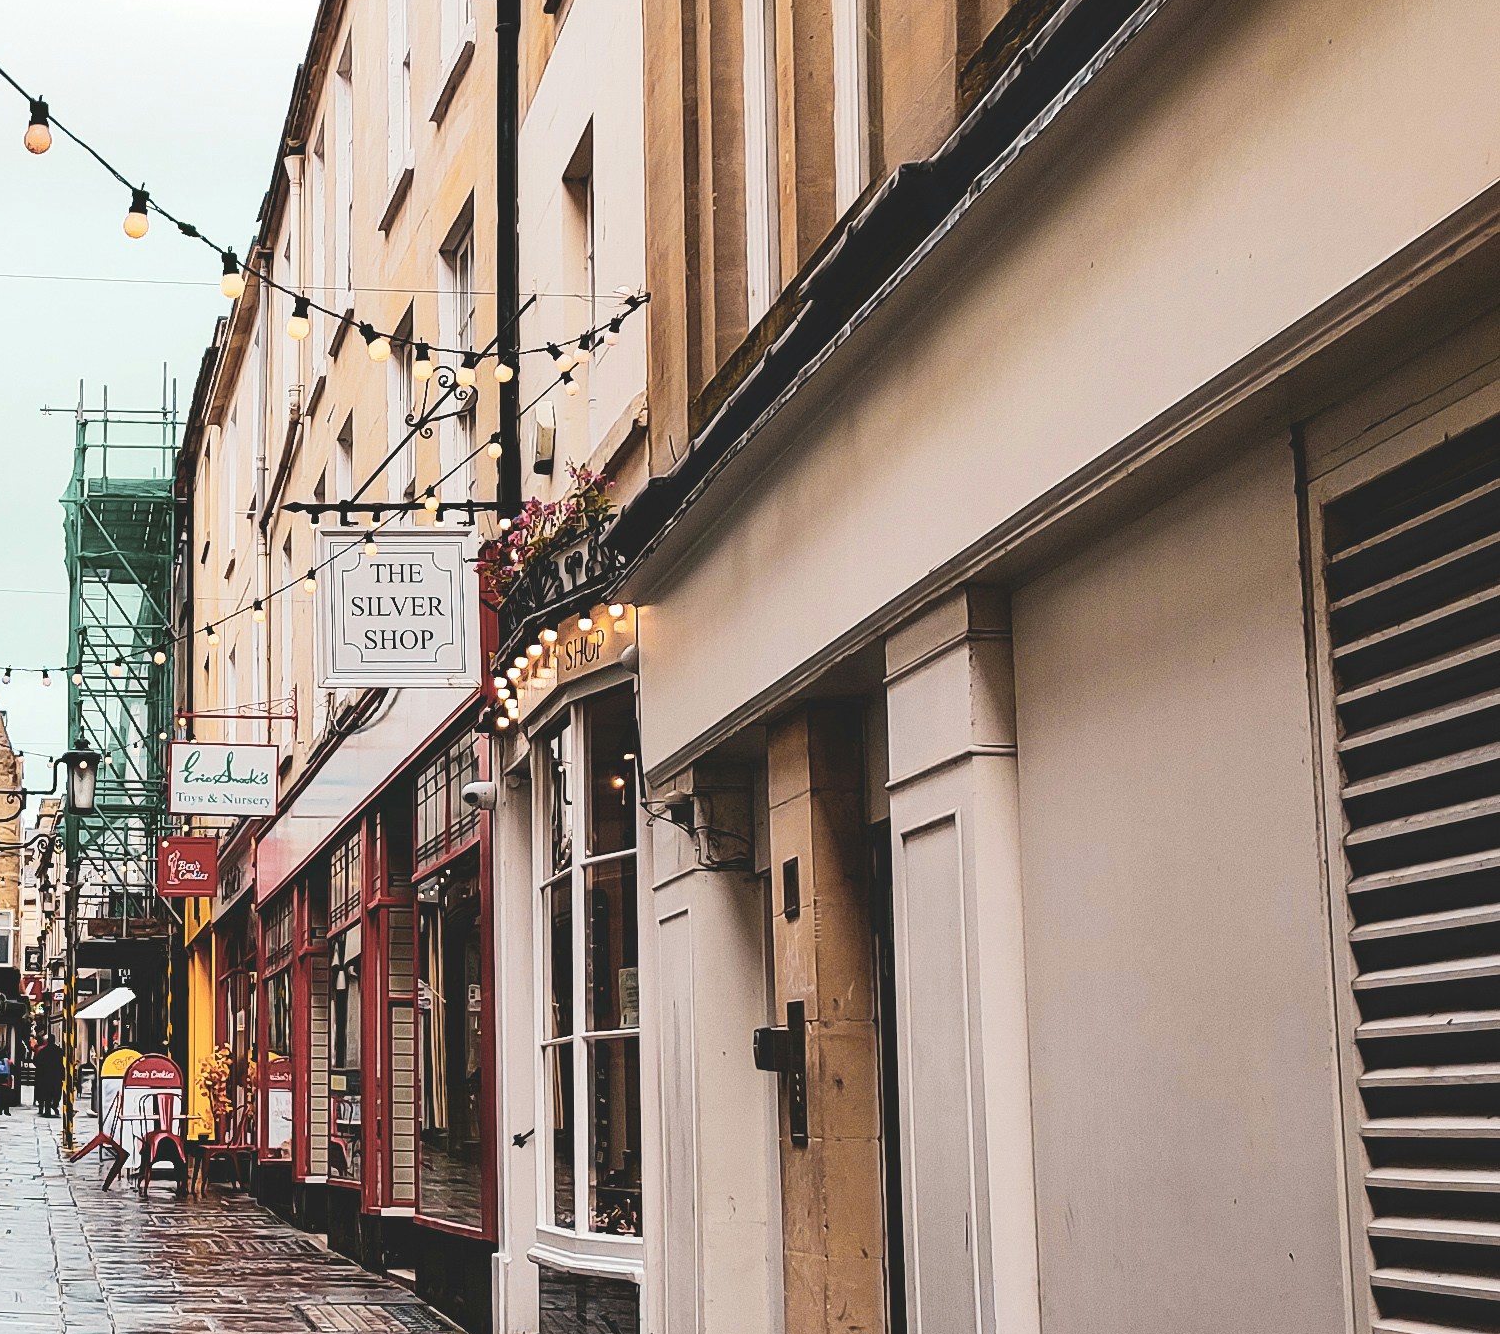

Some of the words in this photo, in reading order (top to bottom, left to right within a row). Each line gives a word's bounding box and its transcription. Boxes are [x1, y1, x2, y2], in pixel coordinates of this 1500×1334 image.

[369, 563, 424, 584] THE
[350, 595, 446, 618] SILVER
[363, 629, 435, 651] SHOP
[565, 629, 605, 672] SHOP
[179, 750, 215, 784] Eric
[176, 791, 204, 807] Toys
[207, 792, 218, 804] &
[222, 793, 271, 809] Nursery
